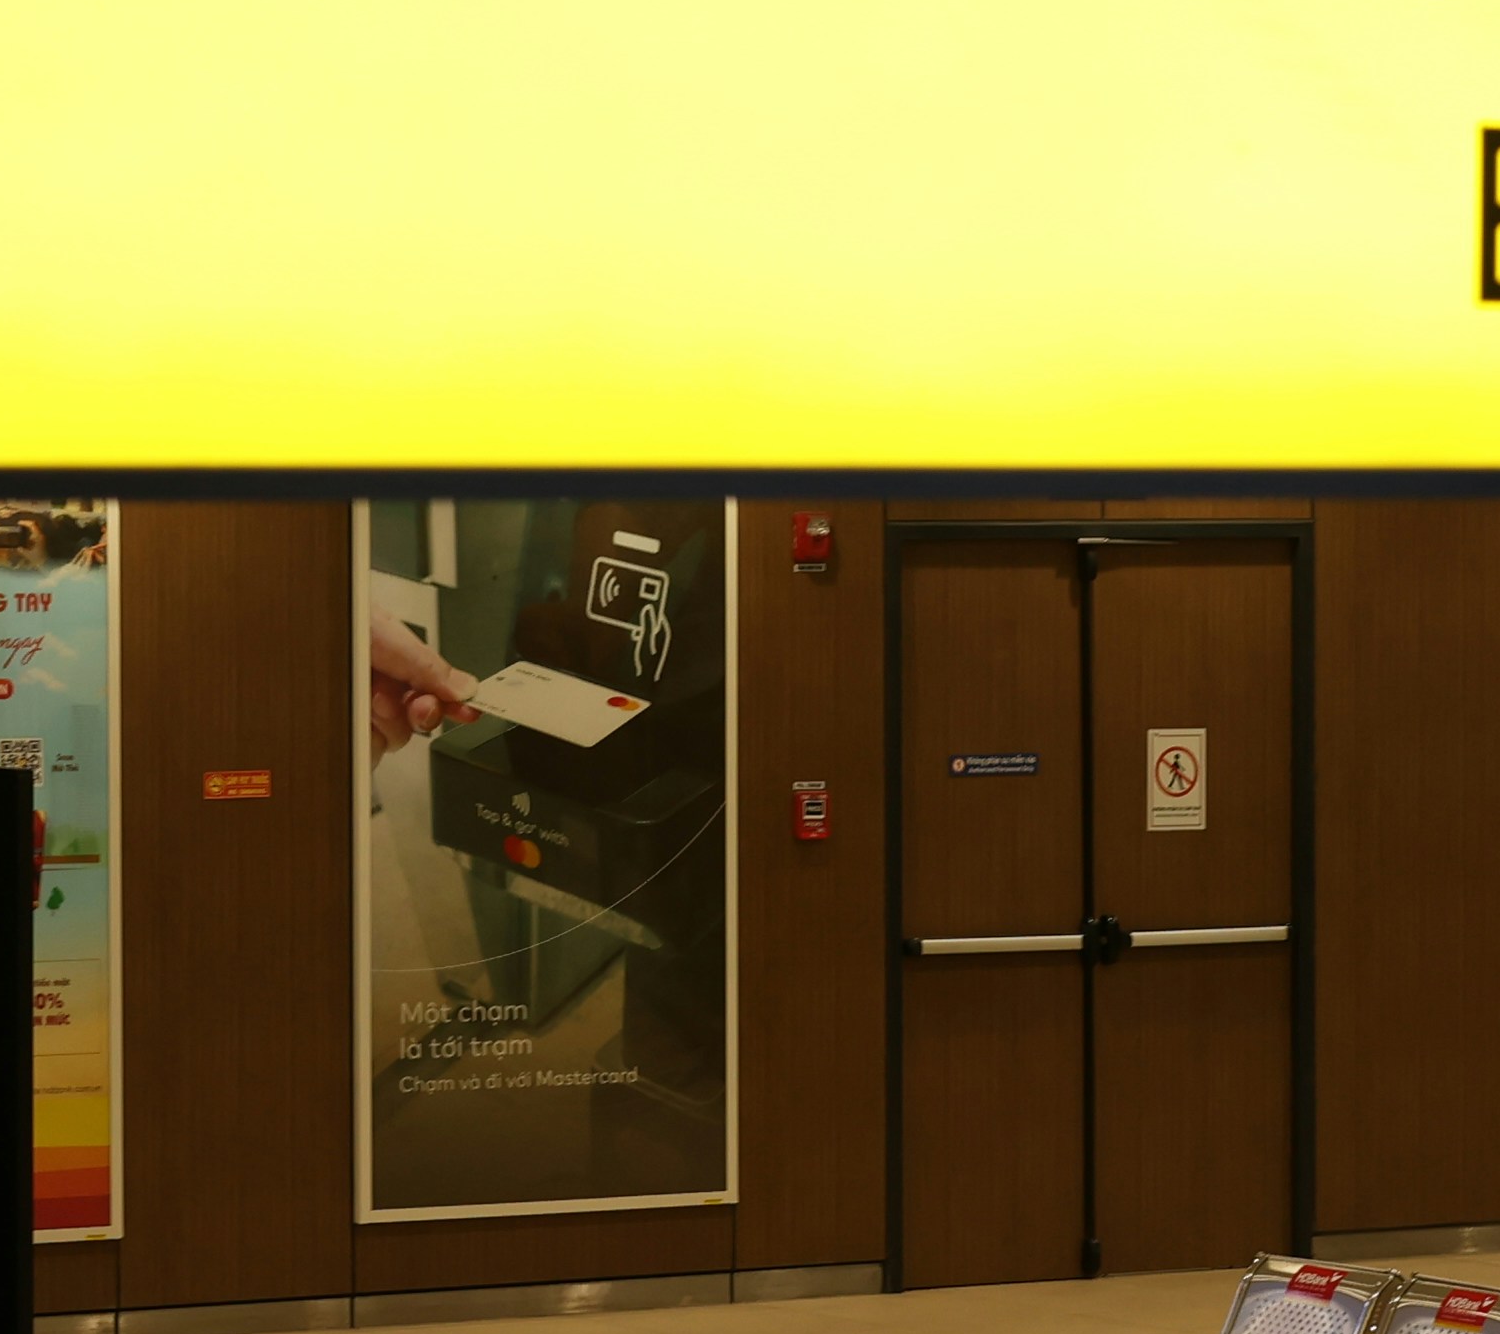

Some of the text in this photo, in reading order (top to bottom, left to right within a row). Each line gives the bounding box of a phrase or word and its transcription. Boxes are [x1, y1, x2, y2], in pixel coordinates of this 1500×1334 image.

[15, 593, 52, 612] TAY
[400, 1000, 528, 1029] Một chạm
[399, 1036, 532, 1060] là tới trạm
[399, 1066, 639, 1095] Chạm và đi với Mastercard
[1297, 1270, 1330, 1285] HDBank
[1447, 1294, 1482, 1310] HDBank
